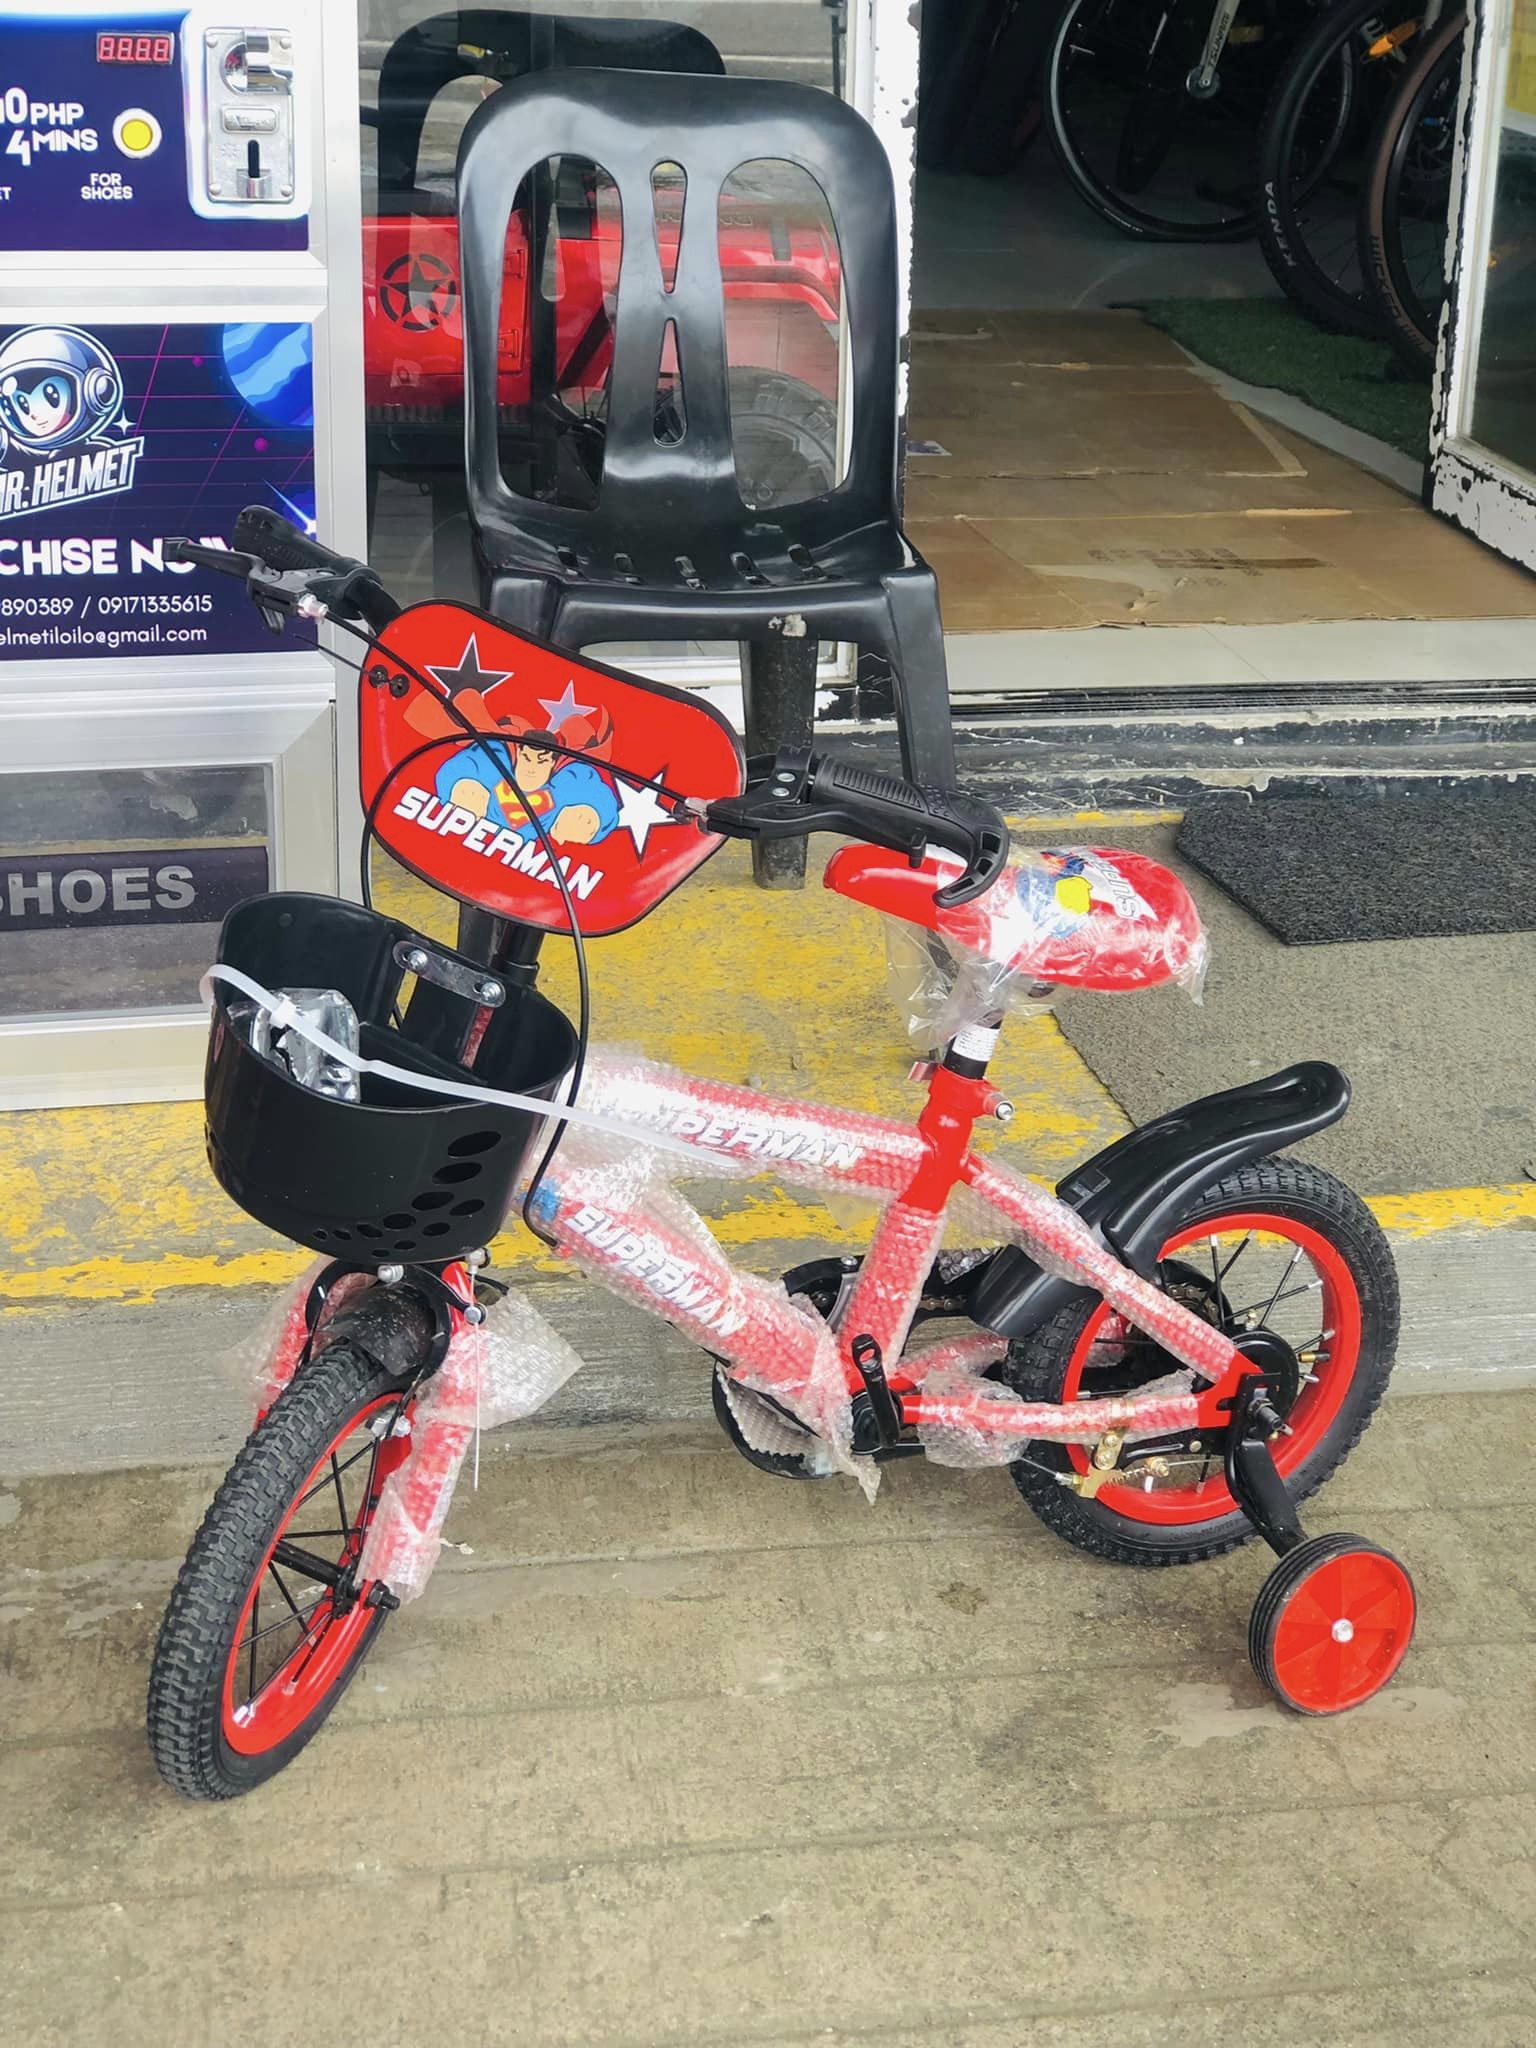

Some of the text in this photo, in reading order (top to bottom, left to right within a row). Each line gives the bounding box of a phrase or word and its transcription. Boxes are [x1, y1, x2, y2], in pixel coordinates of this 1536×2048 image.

[81, 186, 133, 200] SHOES
[90, 172, 122, 186] FOR
[1264, 181, 1297, 267] KENDA
[98, 594, 212, 614] 09171335615
[393, 786, 603, 901] SUPERMAN
[0, 865, 196, 917] HOES
[562, 1204, 748, 1337] SUPERMAN
